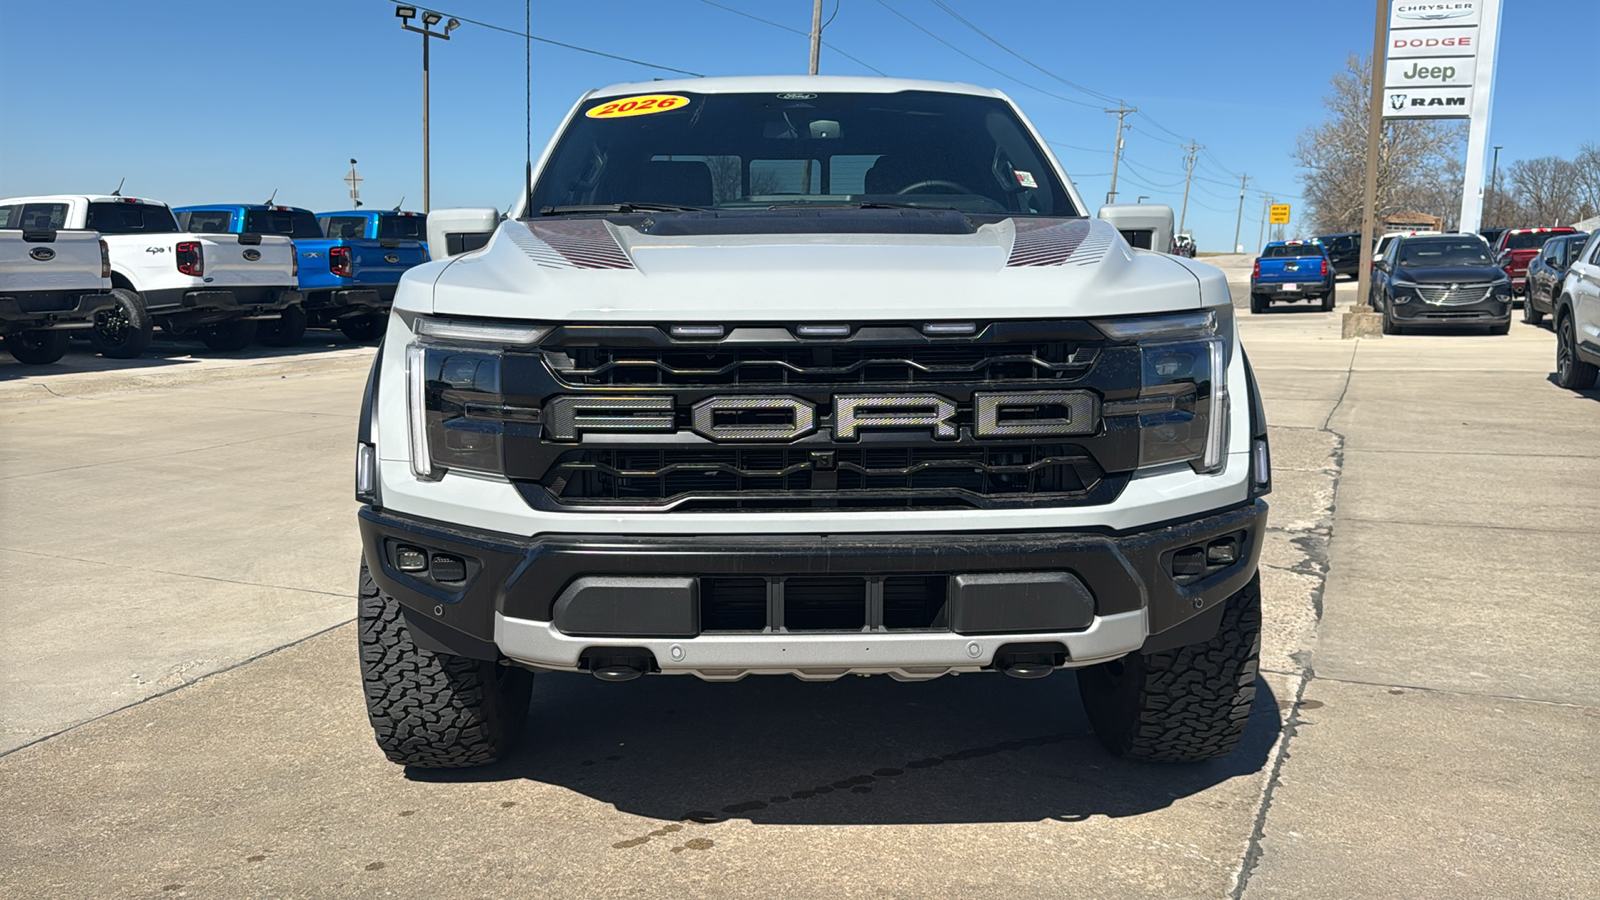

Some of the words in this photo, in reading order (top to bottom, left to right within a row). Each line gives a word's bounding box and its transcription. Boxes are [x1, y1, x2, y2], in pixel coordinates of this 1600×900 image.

[1398, 3, 1473, 12] CHRYSLER
[1394, 37, 1471, 48] DODGE
[1403, 63, 1456, 82] Jeep
[596, 98, 679, 116] 2026
[1411, 97, 1466, 106] RAM
[543, 391, 1103, 443] FORD
